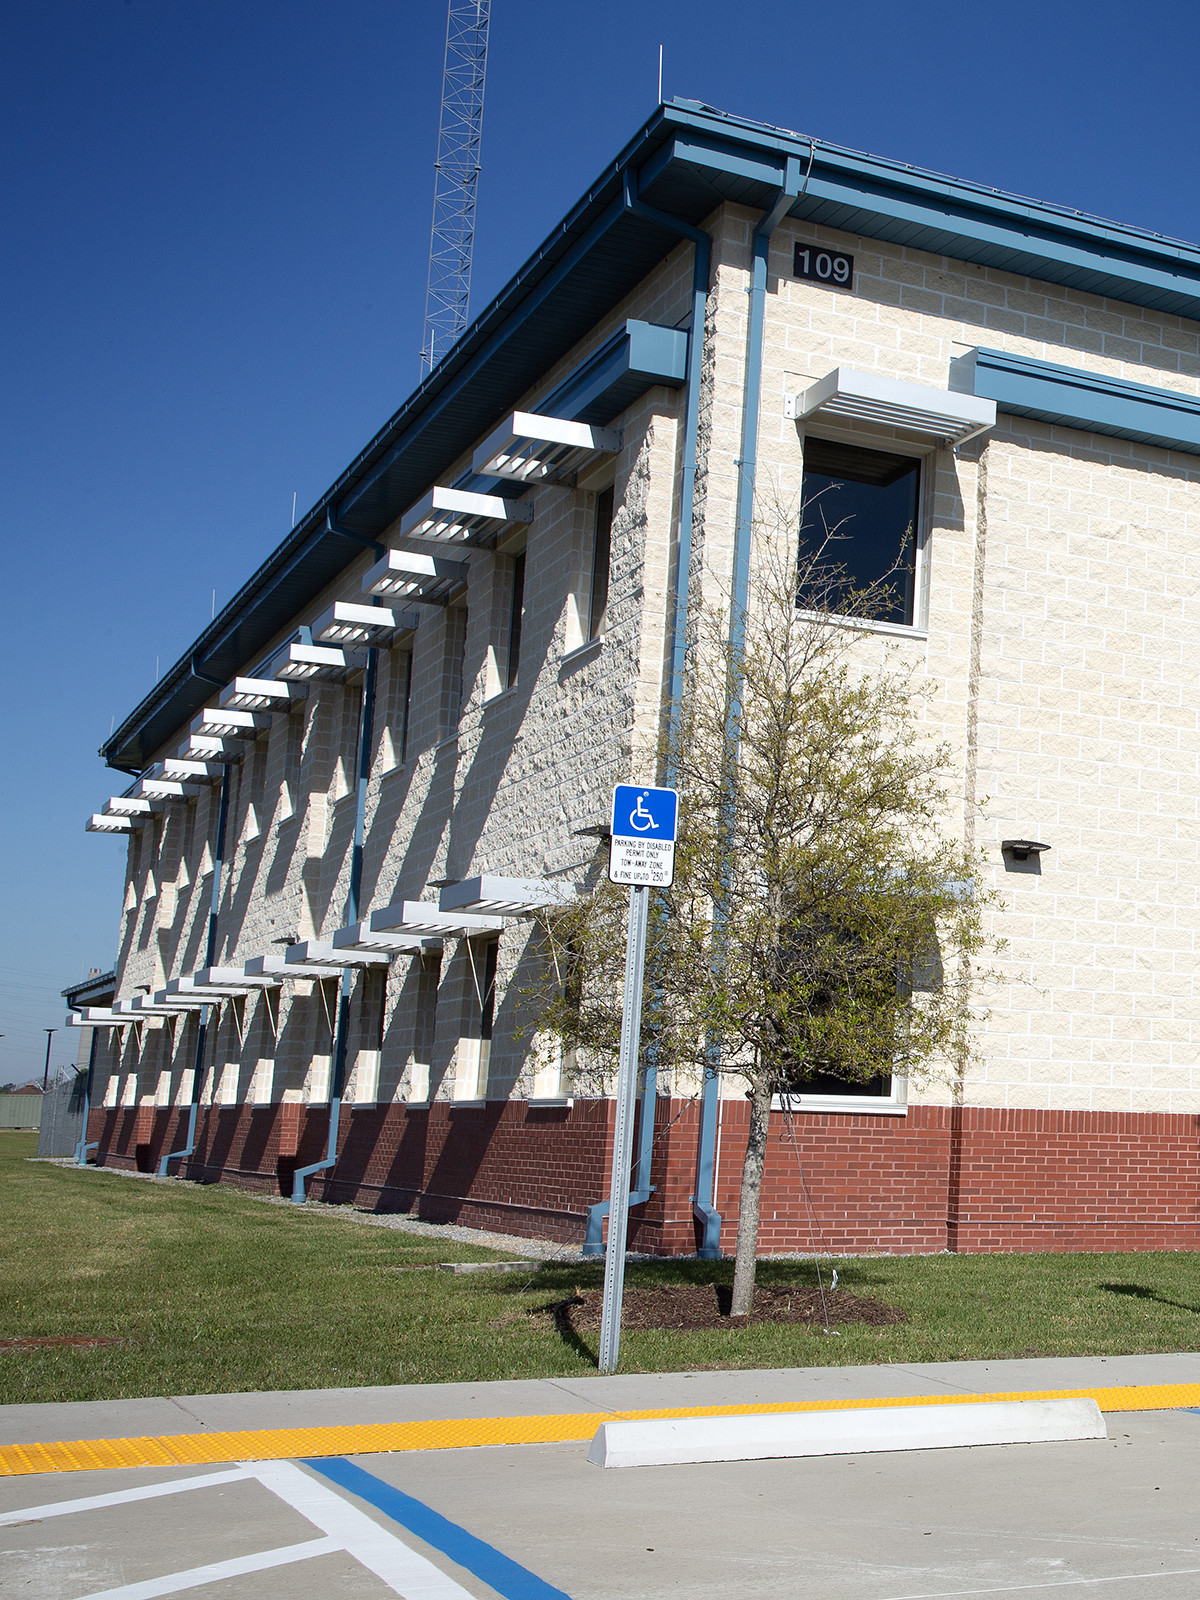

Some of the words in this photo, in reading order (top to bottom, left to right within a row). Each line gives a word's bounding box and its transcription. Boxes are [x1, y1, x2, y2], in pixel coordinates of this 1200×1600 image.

[799, 250, 849, 282] 109
[615, 839, 636, 848] PARKING
[638, 840, 645, 848] BY
[647, 842, 671, 851] DISABLED
[626, 849, 644, 857] PERMIT
[620, 871, 631, 879] FINE
